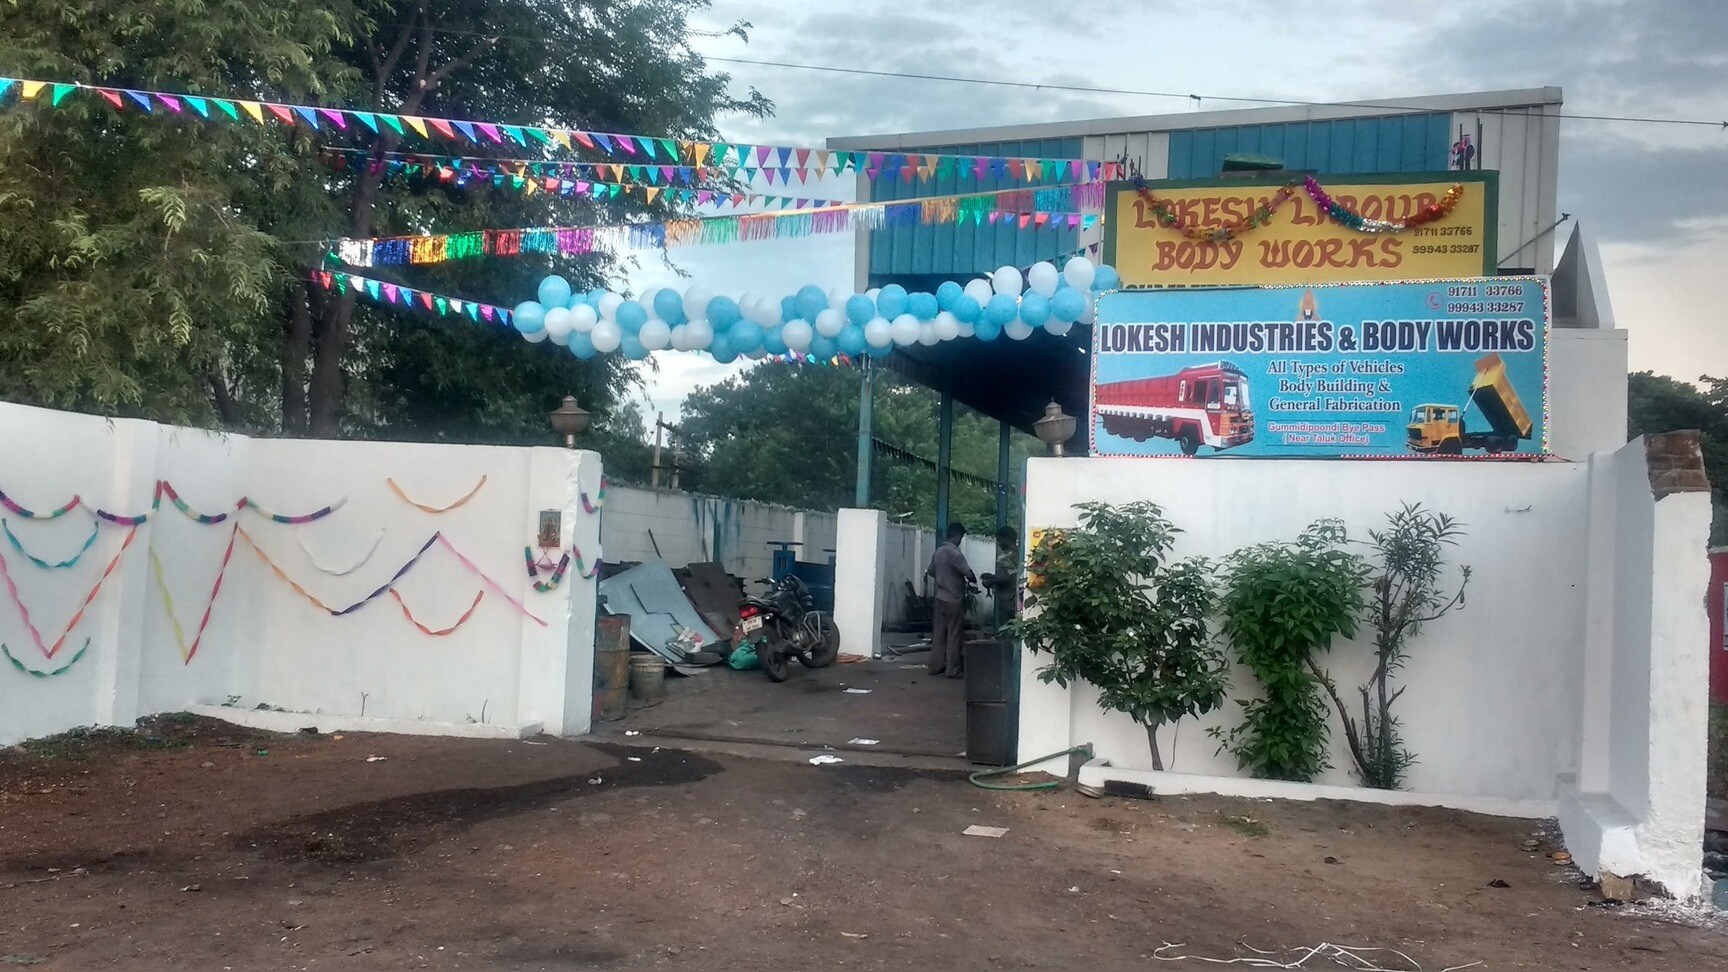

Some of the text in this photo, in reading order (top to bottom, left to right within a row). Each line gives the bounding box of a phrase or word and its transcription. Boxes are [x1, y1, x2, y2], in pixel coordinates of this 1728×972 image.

[1440, 226, 1472, 236] 33766
[1412, 244, 1480, 254] 99943 33287
[1152, 238, 1403, 274] BODY WORKS
[1448, 285, 1523, 297] 91711 33766
[1447, 302, 1524, 313] 99943 33287
[1101, 320, 1534, 353] LOKESH INDUSTRIES & BODY WORKS
[1268, 360, 1404, 377] All Types of Vehicles
[1280, 379, 1391, 395] Body Building &
[1270, 398, 1401, 411] General Fabrication
[1268, 423, 1385, 433] Gummidipoondi Bye Pass
[1312, 434, 1336, 442] Taluk
[1338, 434, 1369, 444] Office)
